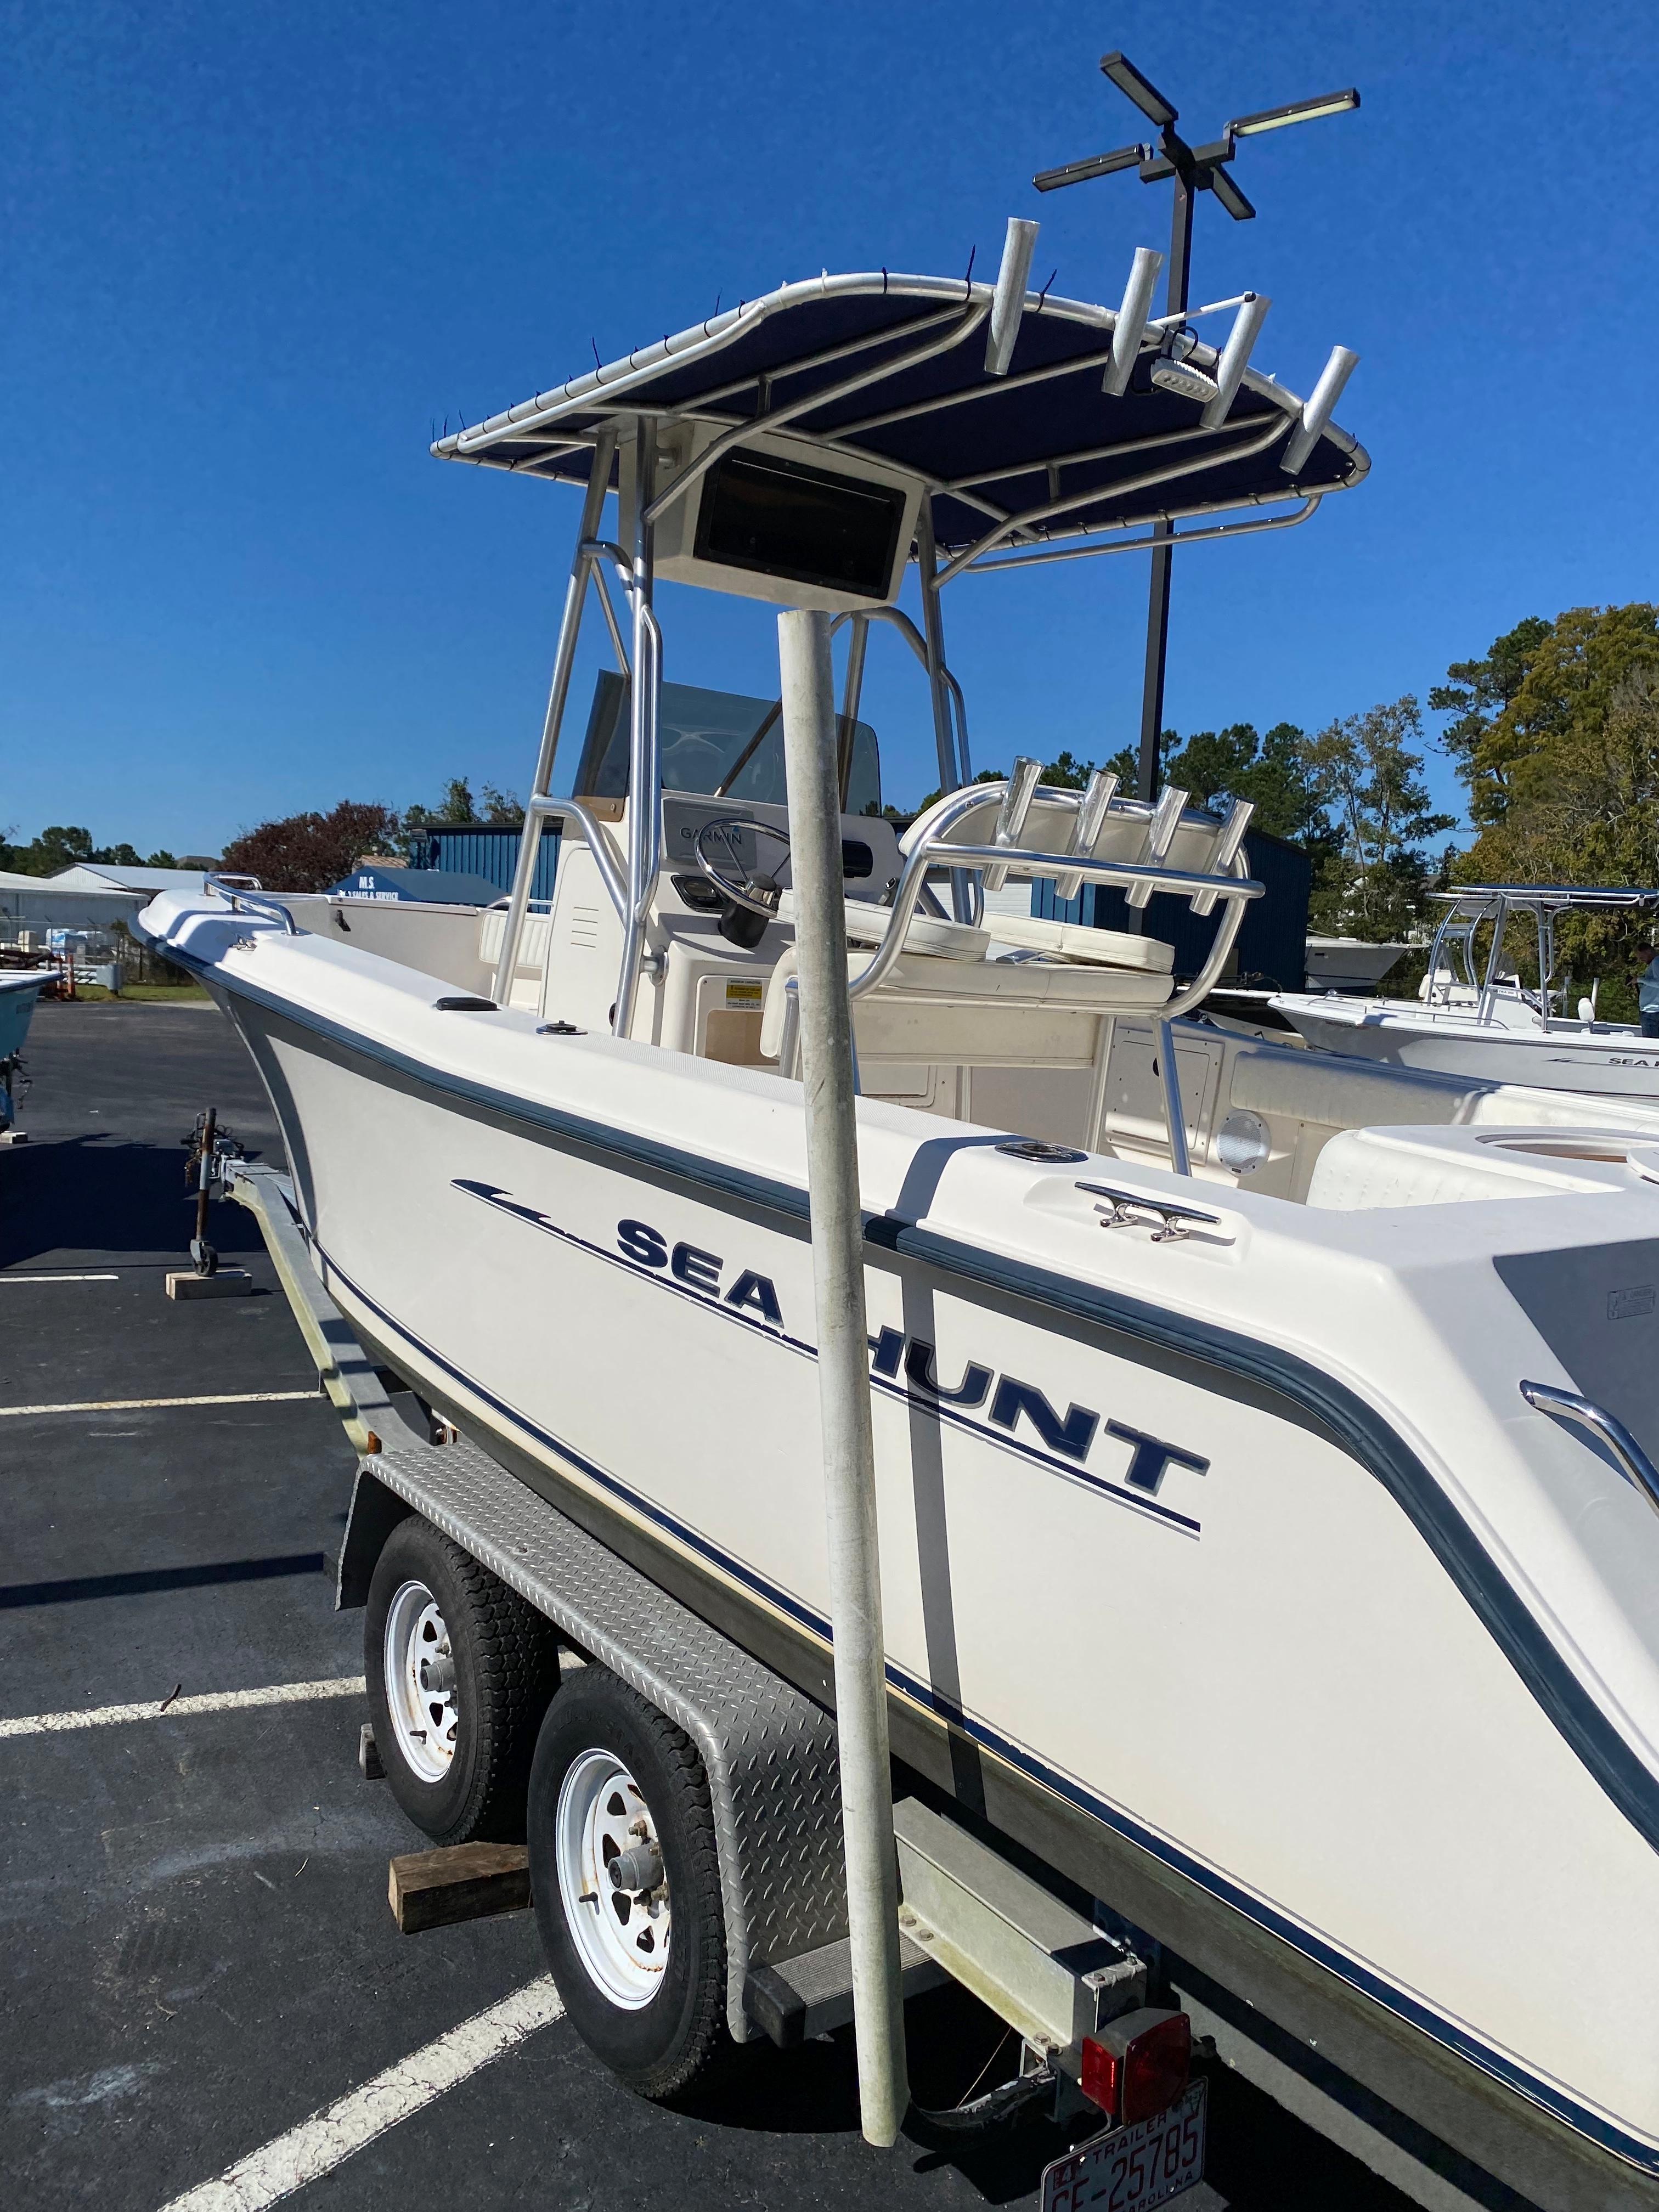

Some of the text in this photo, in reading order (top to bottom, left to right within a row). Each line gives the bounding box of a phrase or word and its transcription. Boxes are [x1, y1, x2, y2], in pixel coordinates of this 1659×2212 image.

[359, 876, 375, 889] M.S.
[376, 891, 398, 900] SERVICE
[1609, 1058, 1649, 1066] SEA
[617, 1219, 785, 1329] SEA
[1092, 2111, 1167, 2164] TRAILER
[1128, 2170, 1193, 2212] AROLINA
